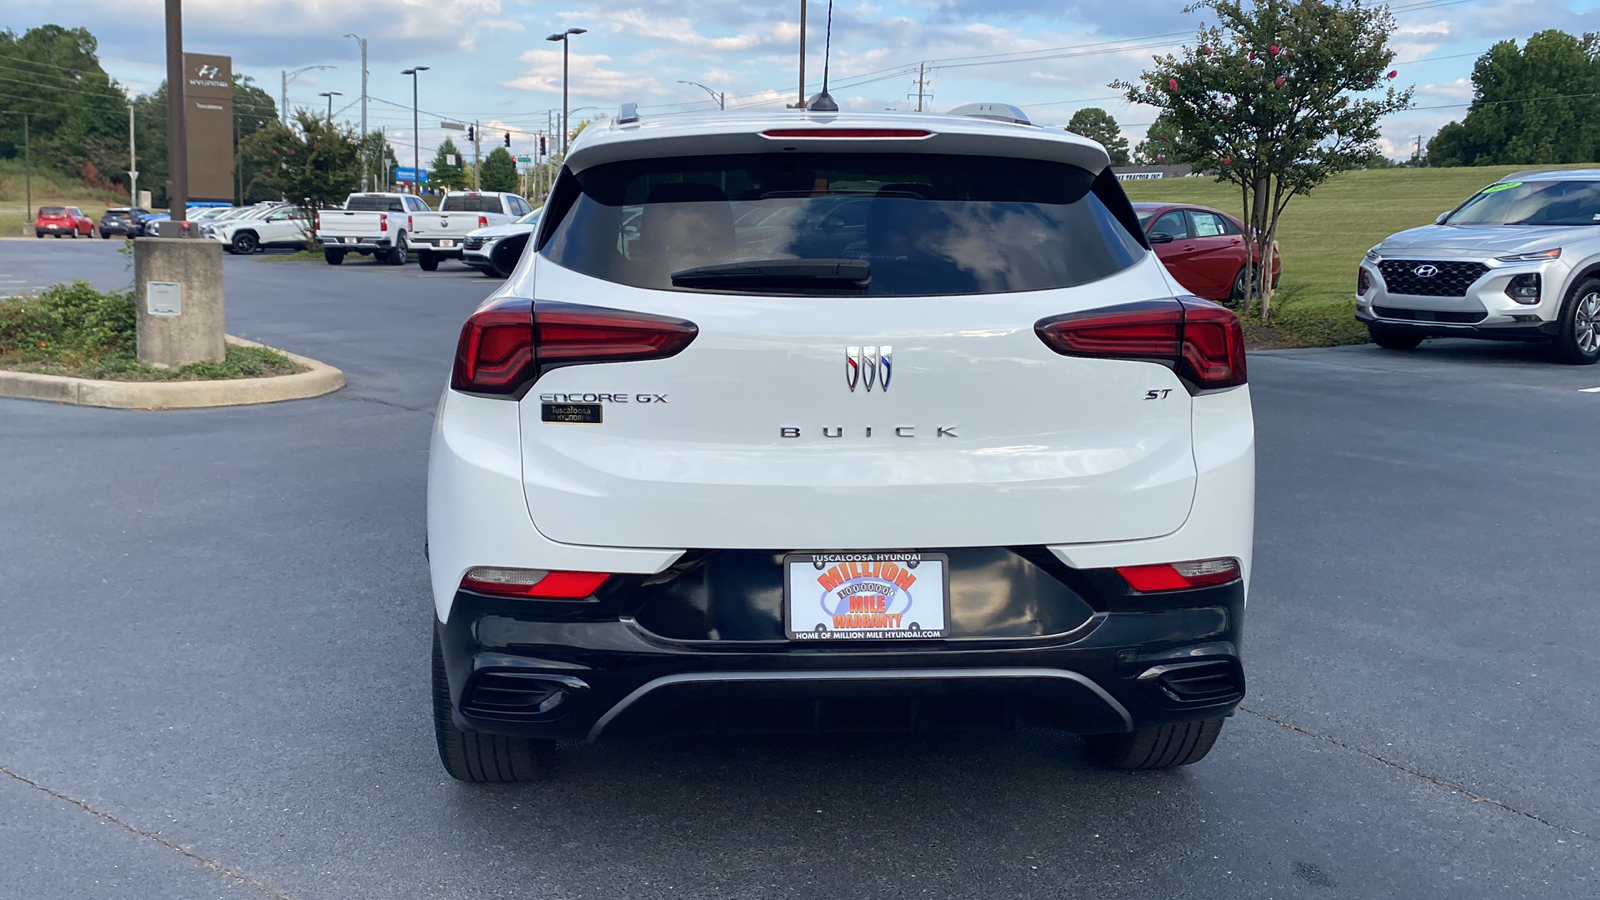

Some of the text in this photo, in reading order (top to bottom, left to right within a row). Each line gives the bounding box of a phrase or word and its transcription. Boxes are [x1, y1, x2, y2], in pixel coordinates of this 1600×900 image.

[189, 79, 228, 87] HYUNDAI
[540, 393, 669, 403] ENCORE GX
[1143, 388, 1173, 400] ST
[552, 406, 591, 414] Tuscaloosa
[780, 426, 959, 438] BUICK
[812, 554, 874, 562] TUSCALOOSA
[817, 562, 917, 593] MILLION
[849, 595, 886, 613] MILE
[832, 614, 903, 629] WARRANTY
